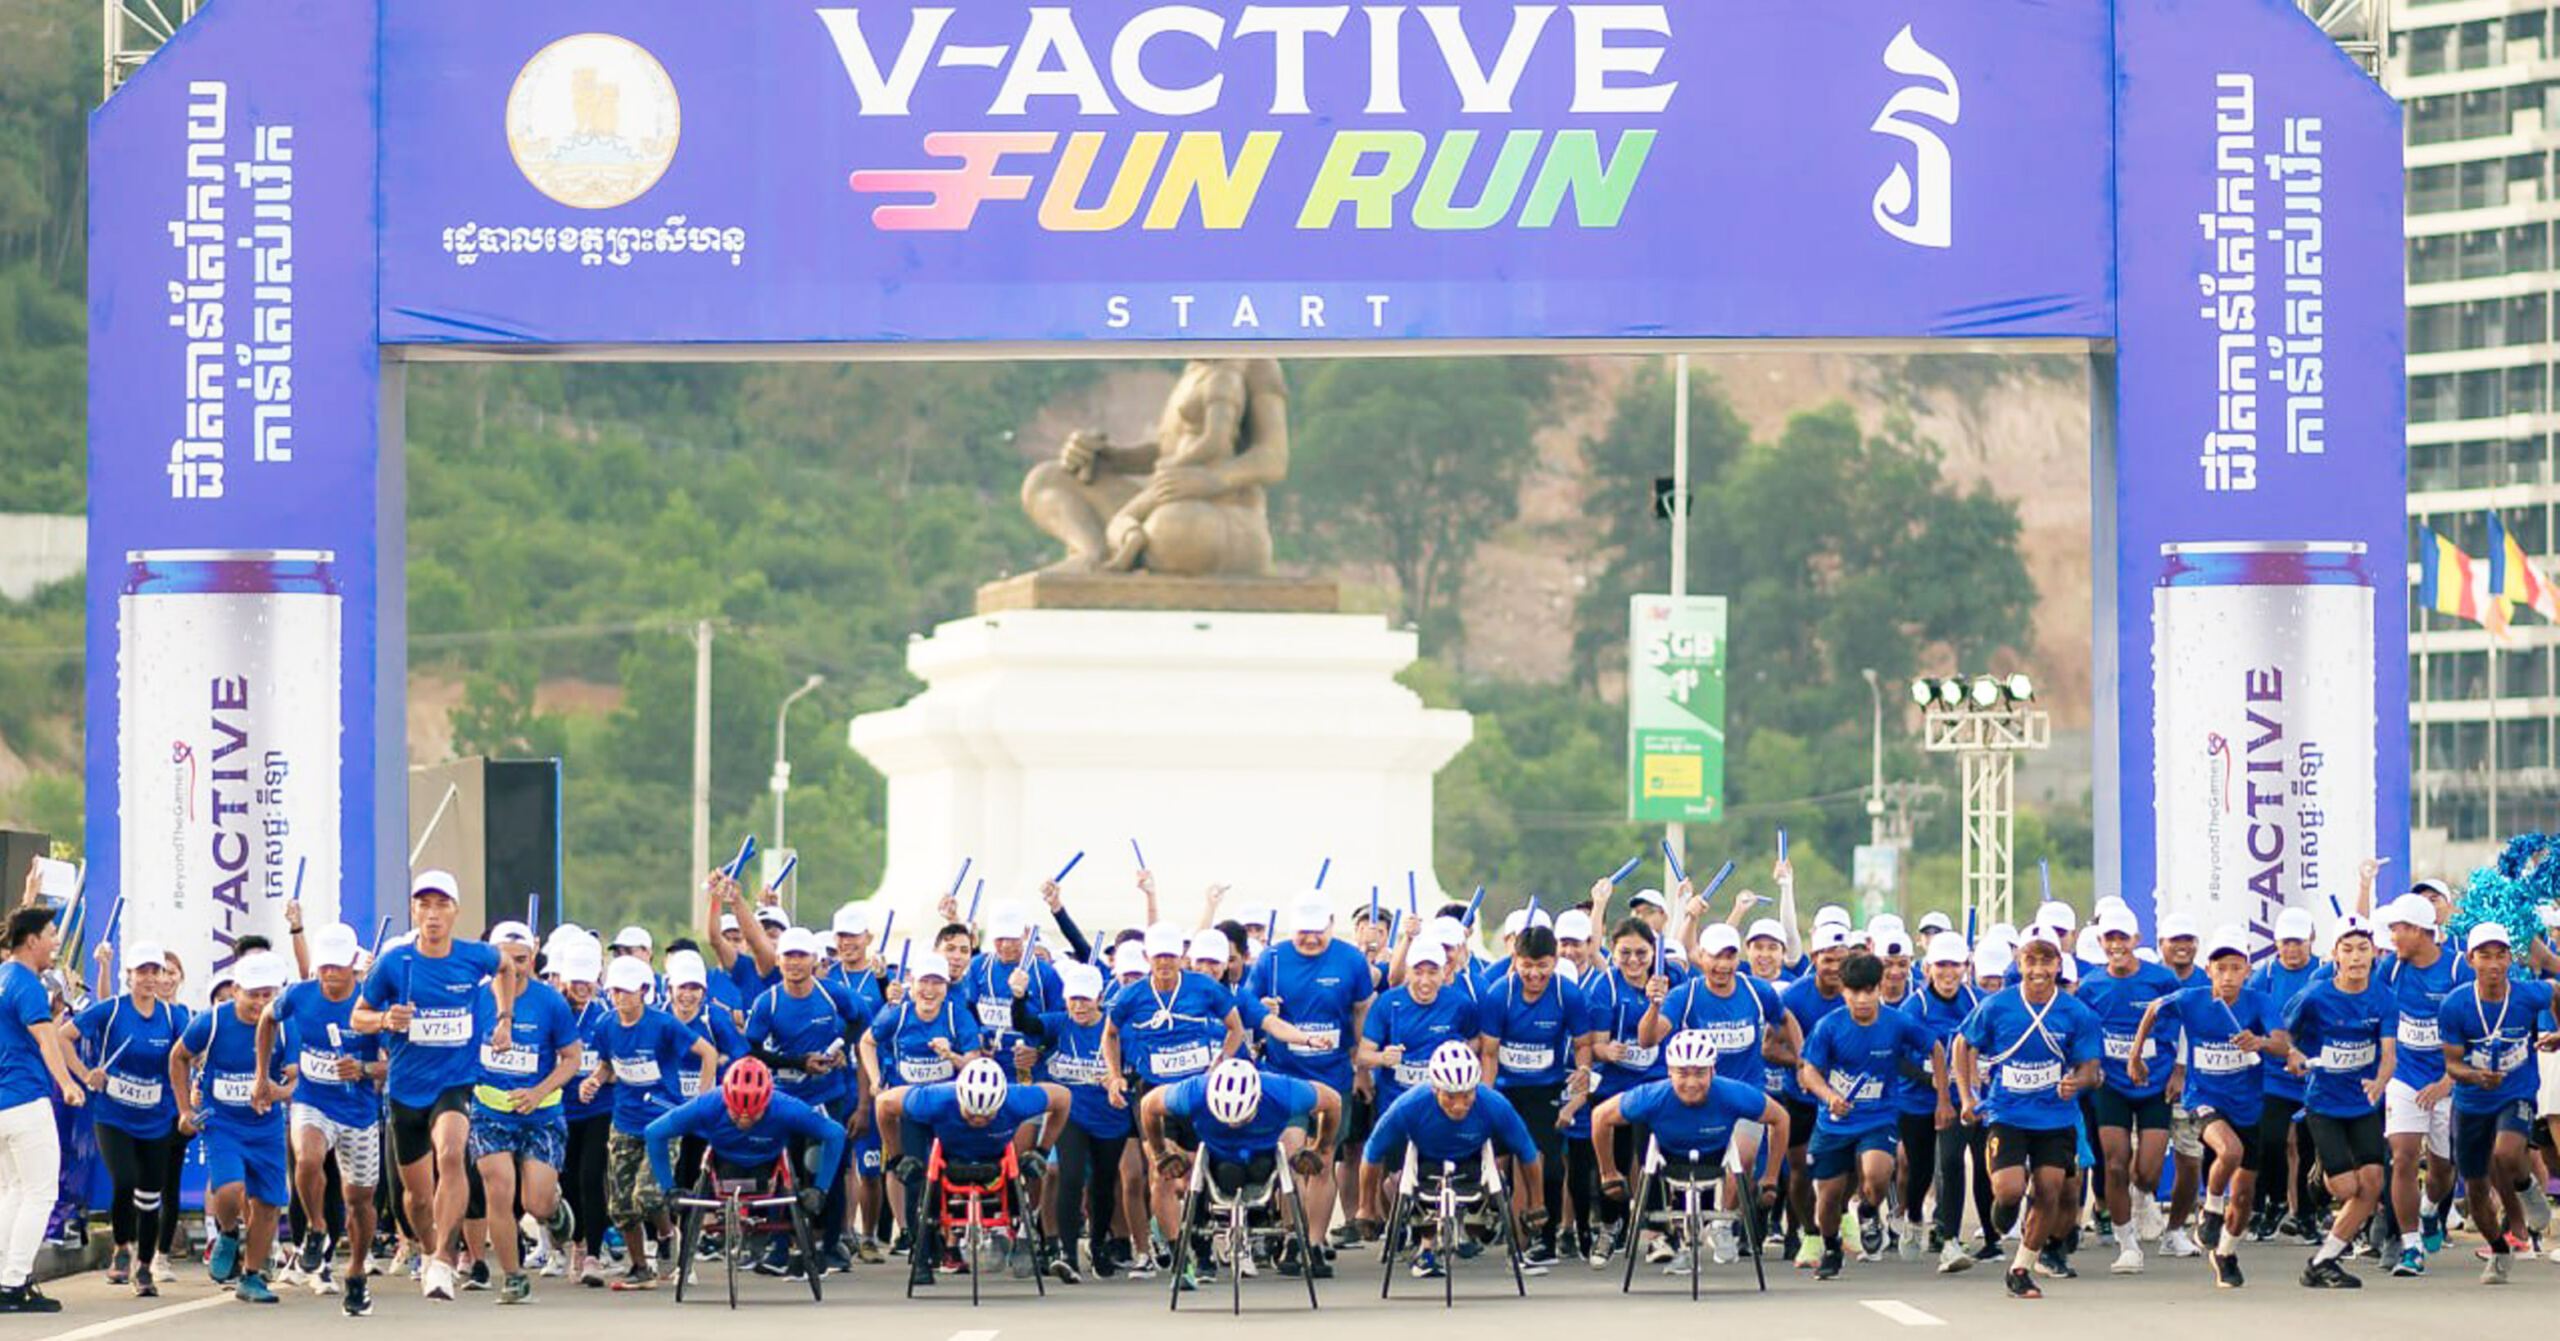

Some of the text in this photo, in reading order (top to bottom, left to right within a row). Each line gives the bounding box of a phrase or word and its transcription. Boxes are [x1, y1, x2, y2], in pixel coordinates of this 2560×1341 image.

[816, 5, 1679, 116] V-ACTIVE
[849, 130, 1658, 231] FUN RUN
[1106, 295, 1390, 328] START
[173, 767, 186, 910] #BeyondTheGames
[212, 674, 249, 974] V-ACTIVE
[2208, 758, 2222, 902] #BeyondTheGames
[2245, 665, 2284, 962] V-ACTIVE
[423, 1022, 463, 1037] V75-1
[2013, 1071, 2051, 1085] V93-1
